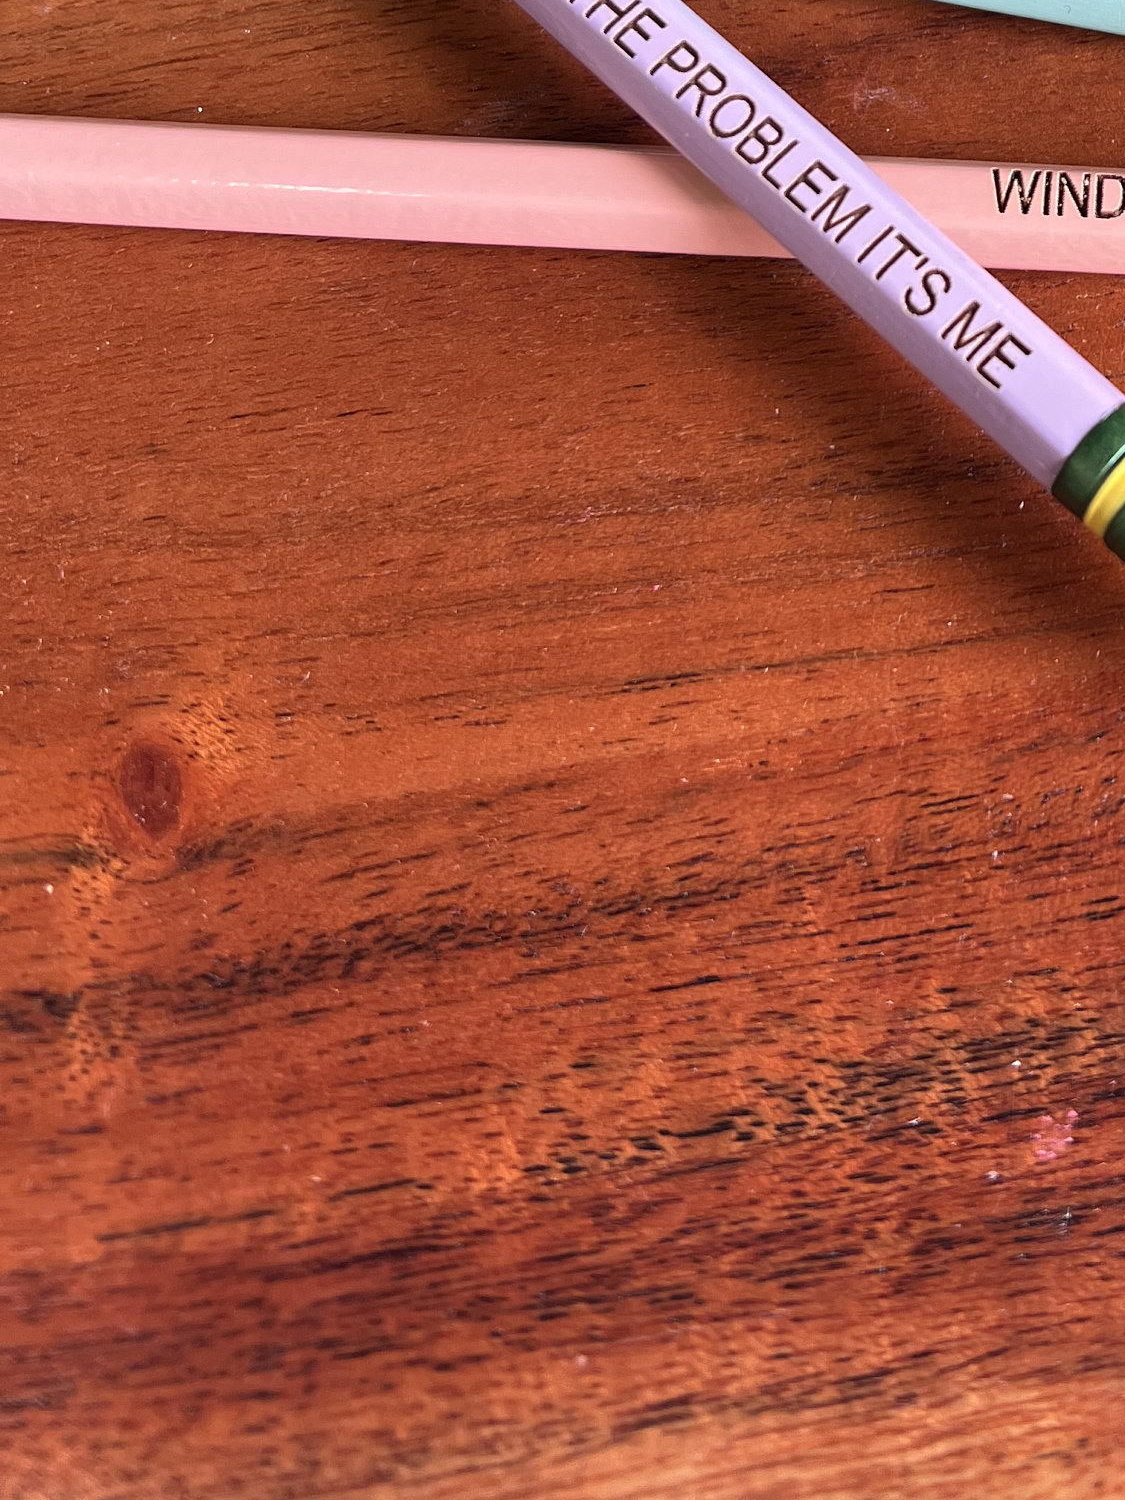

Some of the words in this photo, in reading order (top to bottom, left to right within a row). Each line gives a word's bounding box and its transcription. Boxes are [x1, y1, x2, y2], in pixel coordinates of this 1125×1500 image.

[650, 40, 873, 244] PROBLEM
[856, 225, 952, 318] IT'S
[940, 301, 1032, 389] ME
